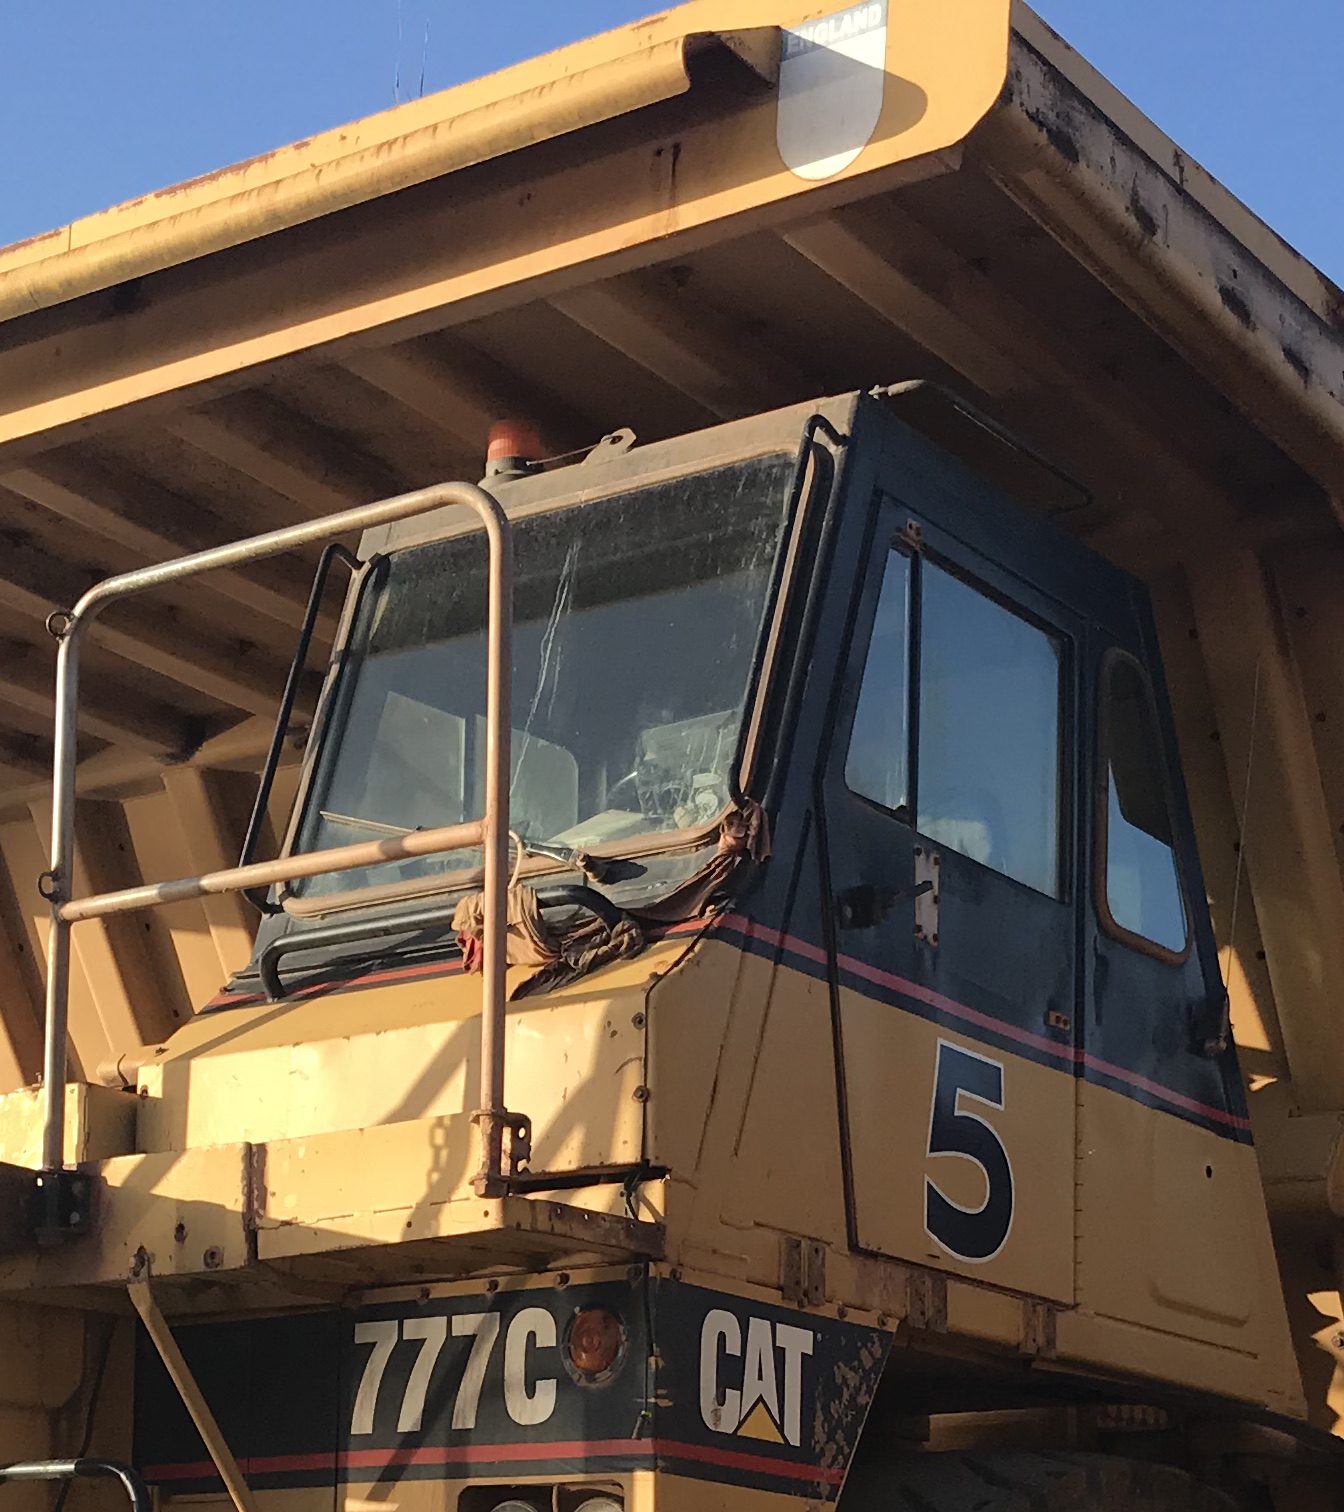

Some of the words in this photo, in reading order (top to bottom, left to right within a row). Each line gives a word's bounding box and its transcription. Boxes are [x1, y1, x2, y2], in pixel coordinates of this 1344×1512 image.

[786, 3, 883, 57] ENGLAND
[924, 1037, 1015, 1264] 5
[350, 1306, 558, 1435] 777C
[699, 1308, 813, 1447] CAT
